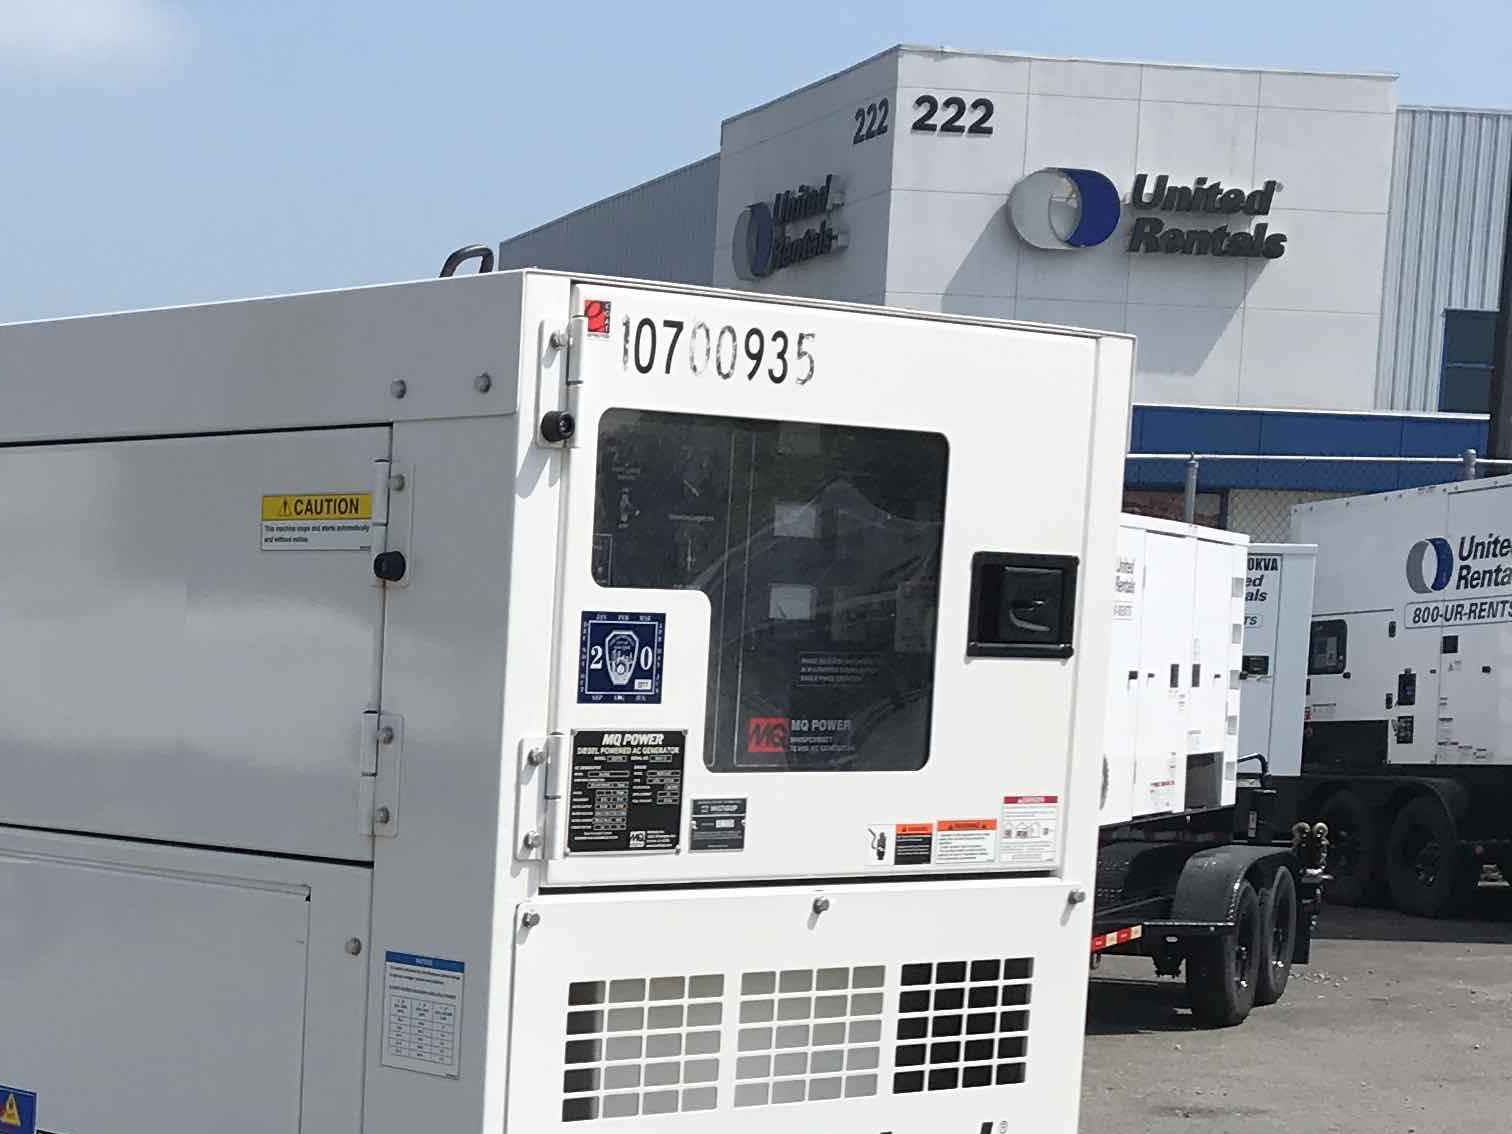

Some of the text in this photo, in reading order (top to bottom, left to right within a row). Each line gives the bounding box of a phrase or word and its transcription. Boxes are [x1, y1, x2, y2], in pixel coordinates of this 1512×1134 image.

[853, 97, 889, 144] 222
[910, 95, 995, 136] 222
[1130, 173, 1277, 216] United
[1126, 216, 1289, 259] Rentals
[622, 313, 816, 385] 10700935
[294, 498, 360, 516] CAUTION
[1459, 533, 1512, 561] Unite
[1248, 558, 1279, 571] 0KVA
[1456, 564, 1512, 590] Renta
[791, 720, 809, 731] MQ
[811, 720, 851, 731] POWER
[601, 734, 664, 746] MQ POWER
